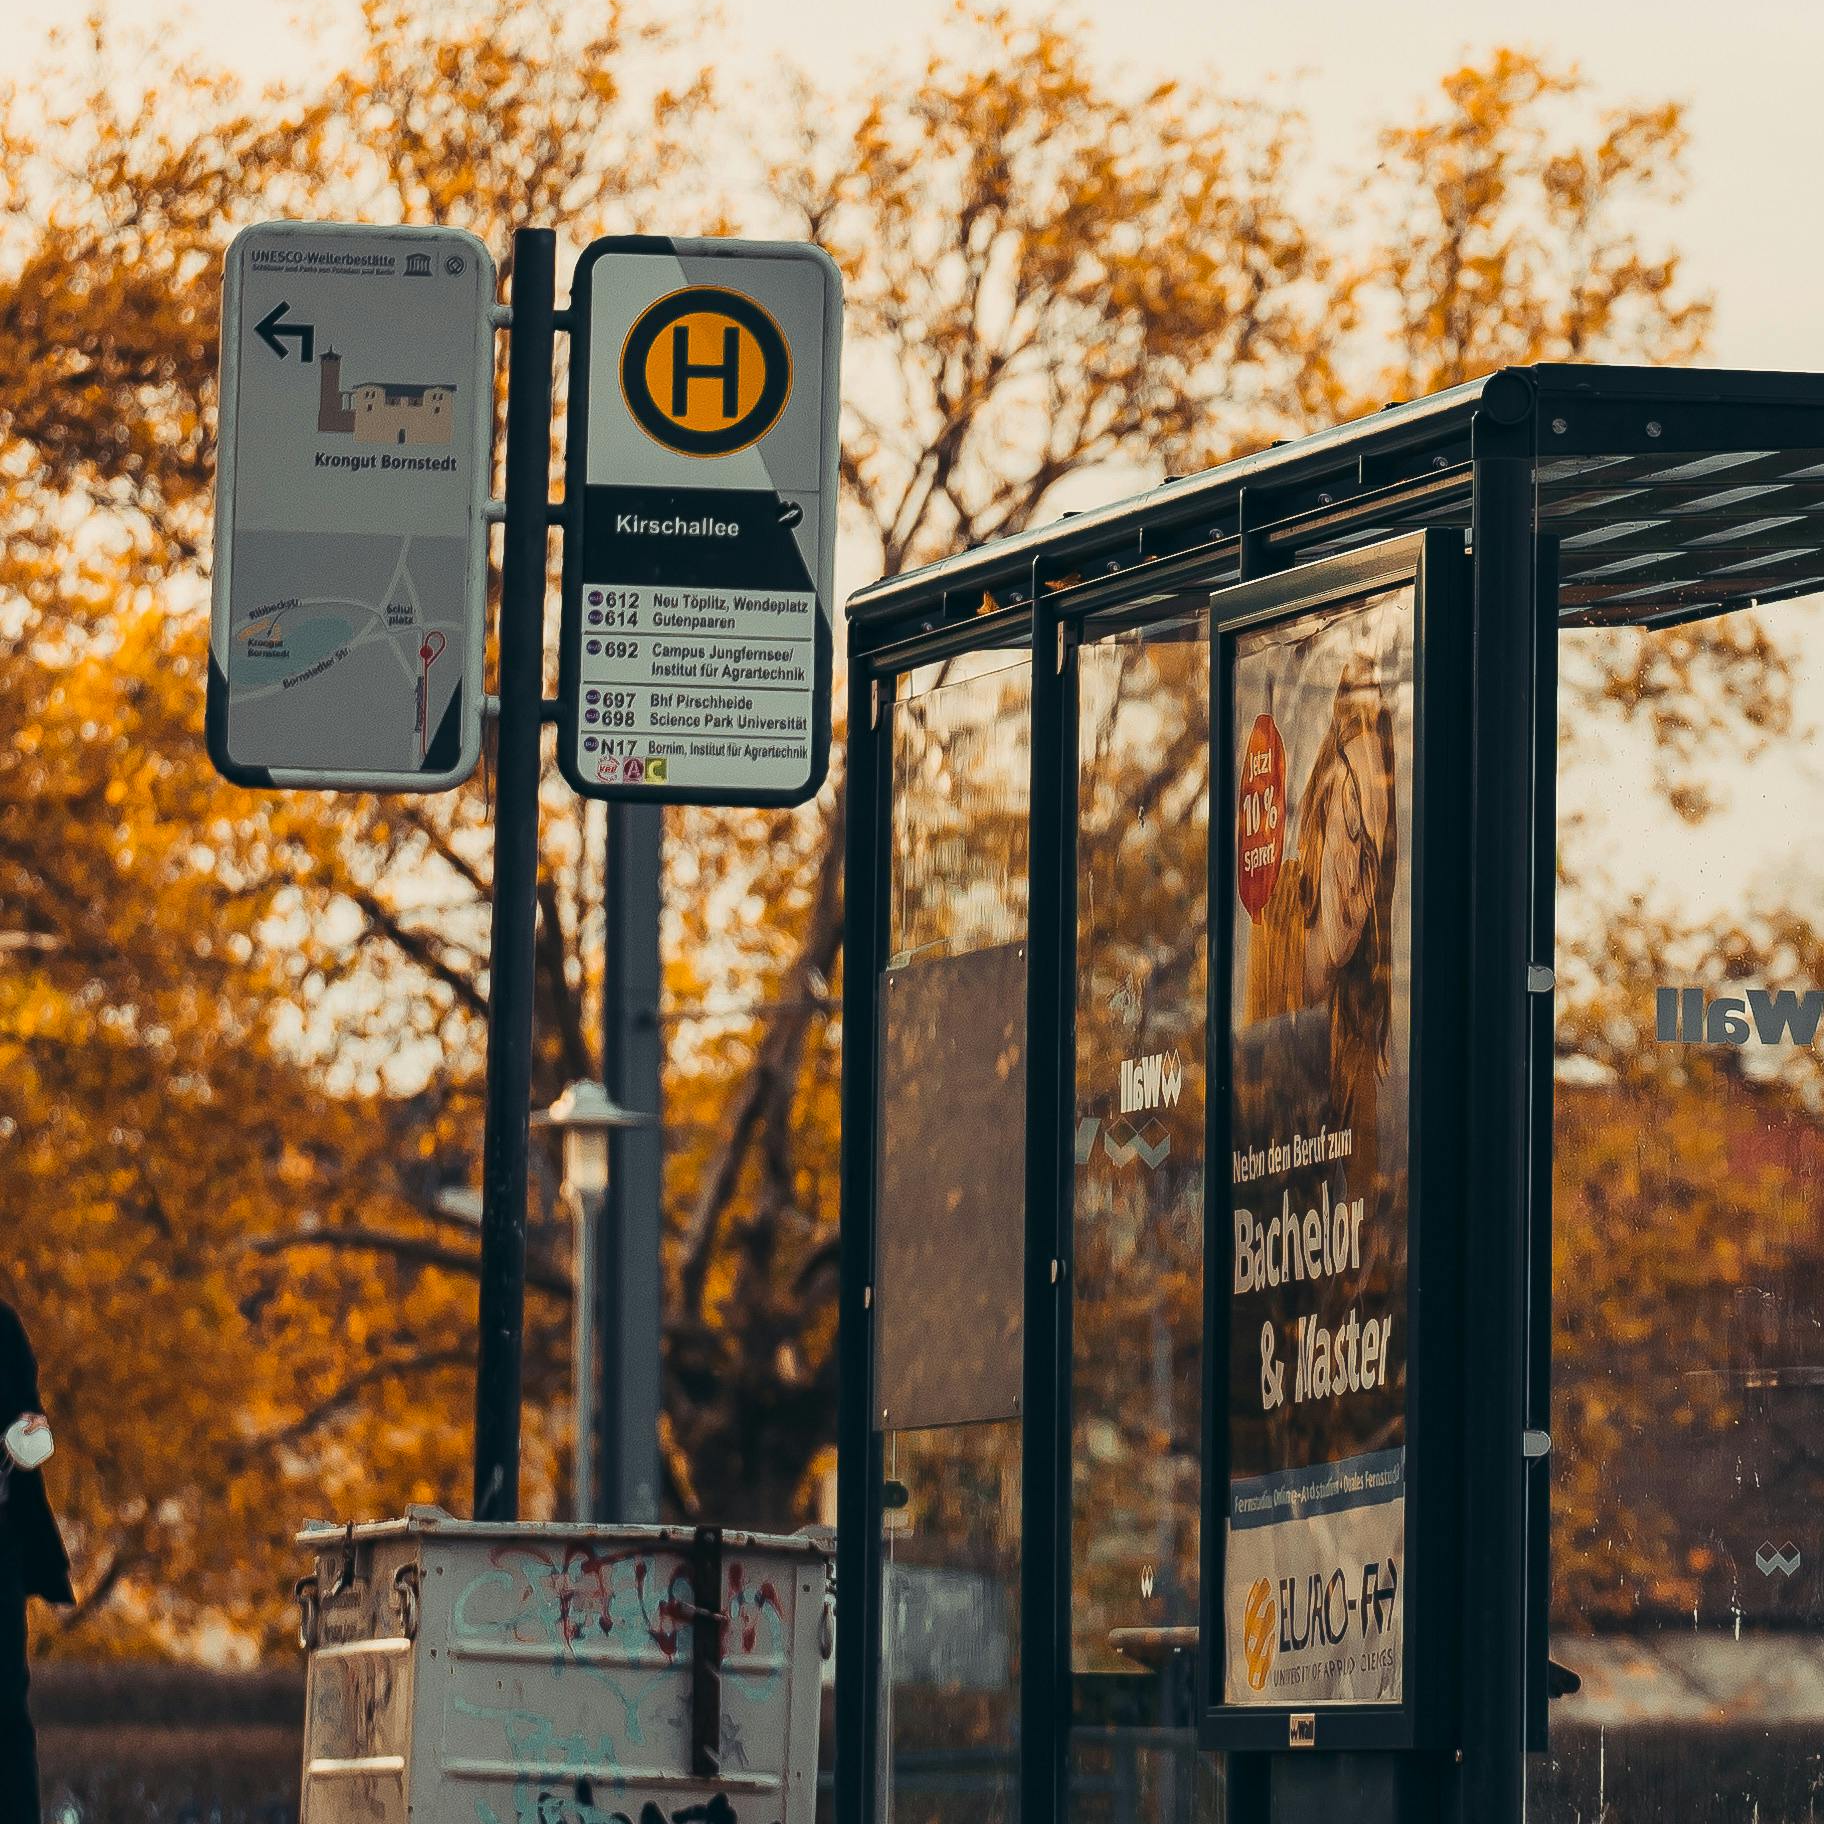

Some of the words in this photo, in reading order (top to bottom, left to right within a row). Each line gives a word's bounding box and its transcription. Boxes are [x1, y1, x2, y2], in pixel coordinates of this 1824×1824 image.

[672, 326, 740, 419] H
[314, 452, 377, 472] Krongut
[381, 454, 457, 472] Bornstedt
[616, 514, 740, 537] Kirschallee
[606, 592, 640, 609] 612
[682, 592, 730, 613] Töplitz,
[733, 596, 809, 615] Wendeplatz
[605, 610, 639, 627] 614
[652, 612, 736, 631] Gutenpaaren
[604, 642, 639, 659] 692
[652, 643, 706, 663] Campus
[709, 645, 794, 664] Jungfernsee/
[651, 661, 697, 678] Institut
[700, 662, 719, 678] für
[722, 664, 806, 683] Agrartechnik
[602, 692, 637, 709] 697
[650, 693, 673, 708] Bhf
[676, 694, 754, 710] Pirschheide
[602, 710, 636, 727] 698
[650, 712, 701, 728] Science
[704, 713, 734, 728] Park
[738, 714, 808, 731] Universität
[601, 739, 638, 756] N17
[648, 740, 688, 757] Bornim,
[690, 741, 725, 757] Institut
[727, 742, 741, 757] für
[743, 744, 808, 761] Agrartechnik
[1243, 790, 1260, 837] 10
[1263, 784, 1278, 830] %
[1293, 1124, 1327, 1168] Beruf
[1328, 1128, 1352, 1160] zum
[1234, 1179, 1364, 1295] Bachelor
[1260, 1320, 1285, 1410] &
[1295, 1307, 1392, 1404] Master
[1279, 1557, 1398, 1654] EURO-FH
